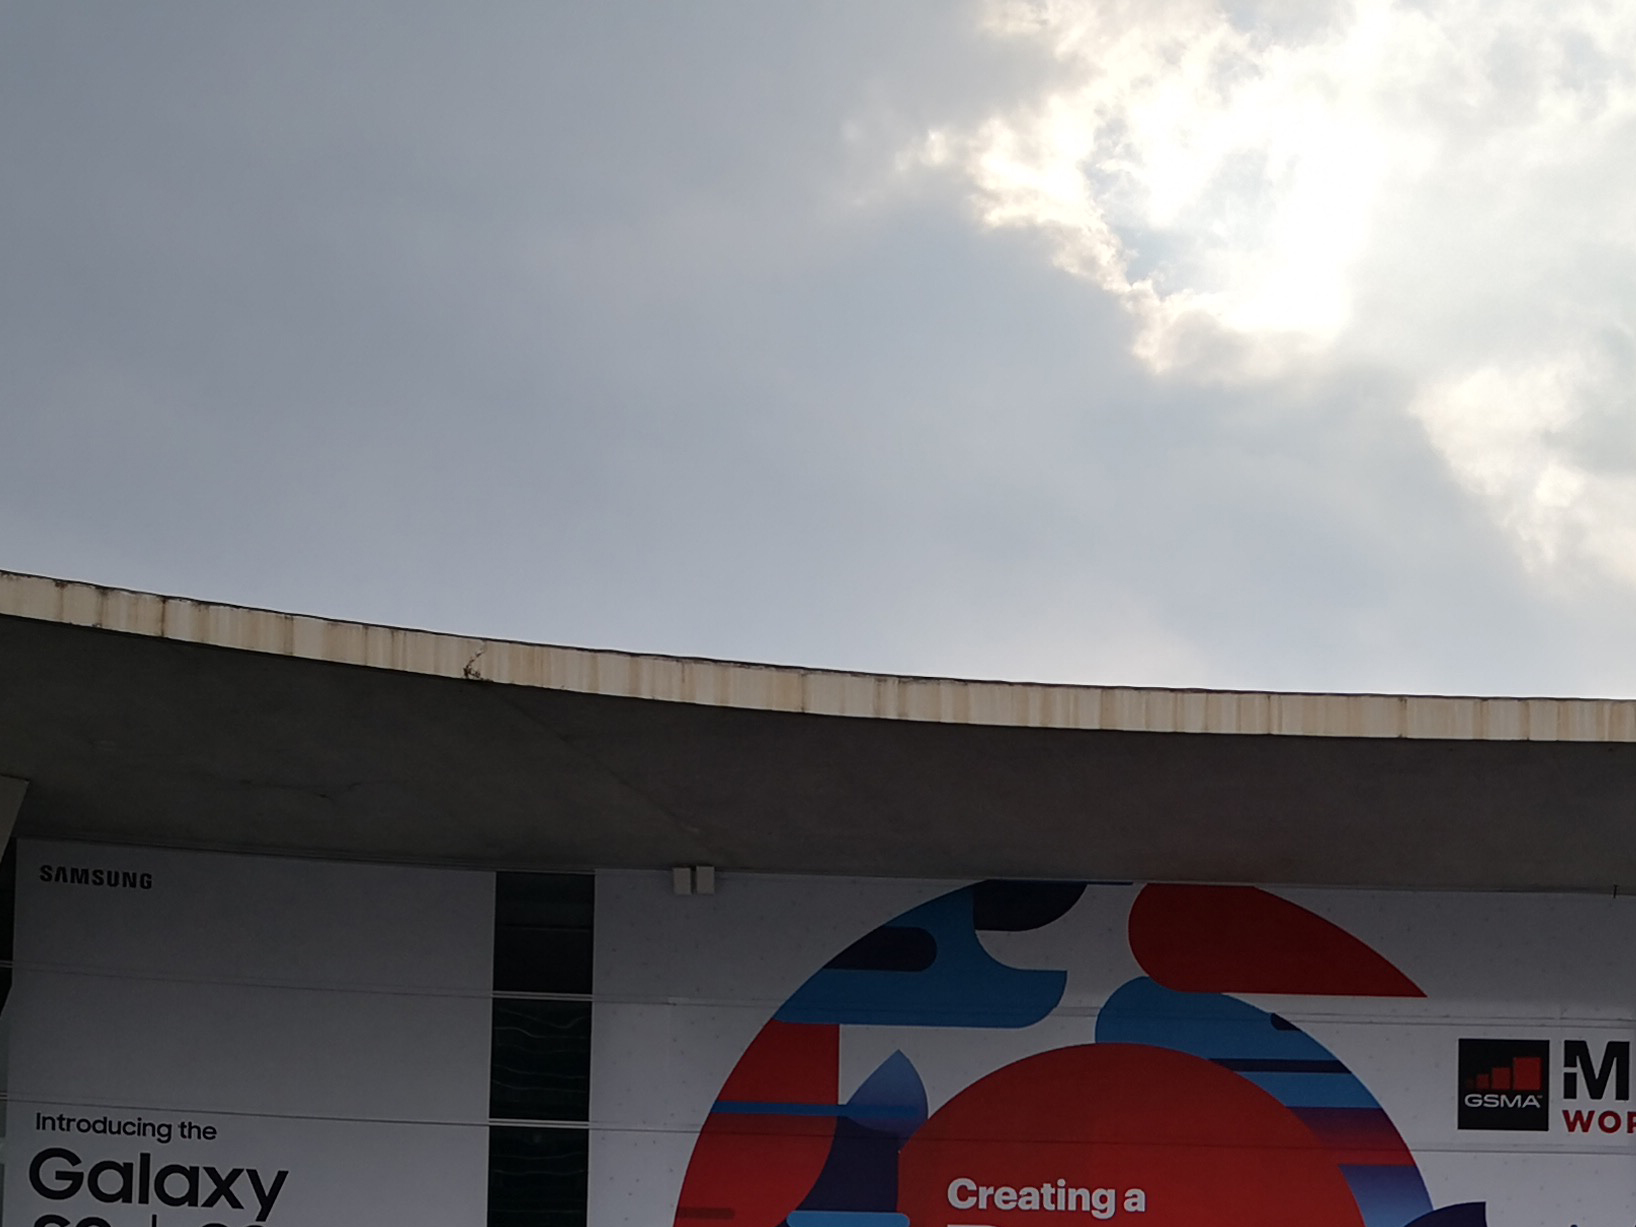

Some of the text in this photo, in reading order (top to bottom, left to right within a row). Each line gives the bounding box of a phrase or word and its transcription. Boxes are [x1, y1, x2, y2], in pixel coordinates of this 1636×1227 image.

[39, 864, 153, 890] SAMSUNG
[1464, 1093, 1541, 1109] GSMA
[35, 1111, 218, 1143] Introducing the
[28, 1147, 289, 1222] Galaxy
[947, 1177, 1146, 1220] Creating a
